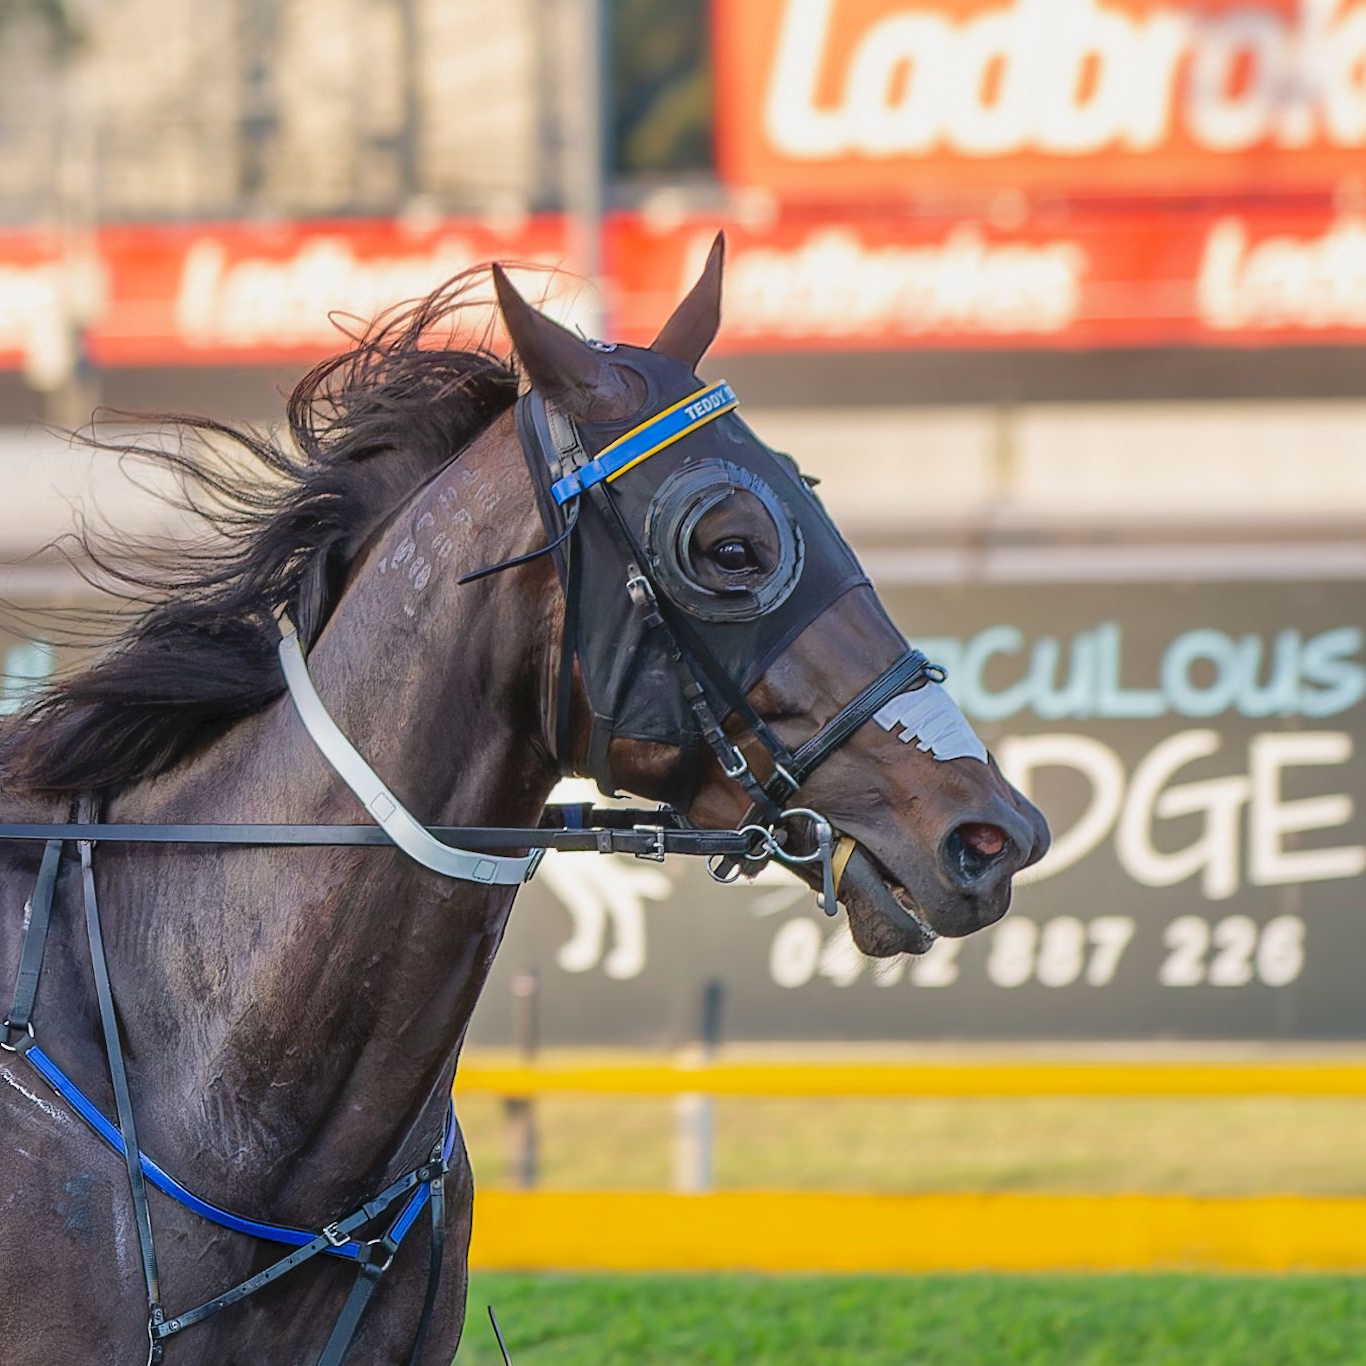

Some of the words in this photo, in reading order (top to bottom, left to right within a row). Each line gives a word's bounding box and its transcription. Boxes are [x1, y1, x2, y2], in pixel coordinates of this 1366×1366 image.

[684, 388, 727, 420] TEDDY
[915, 622, 1365, 721] CULOUS
[987, 916, 1135, 988] 887
[1157, 916, 1306, 988] 226
